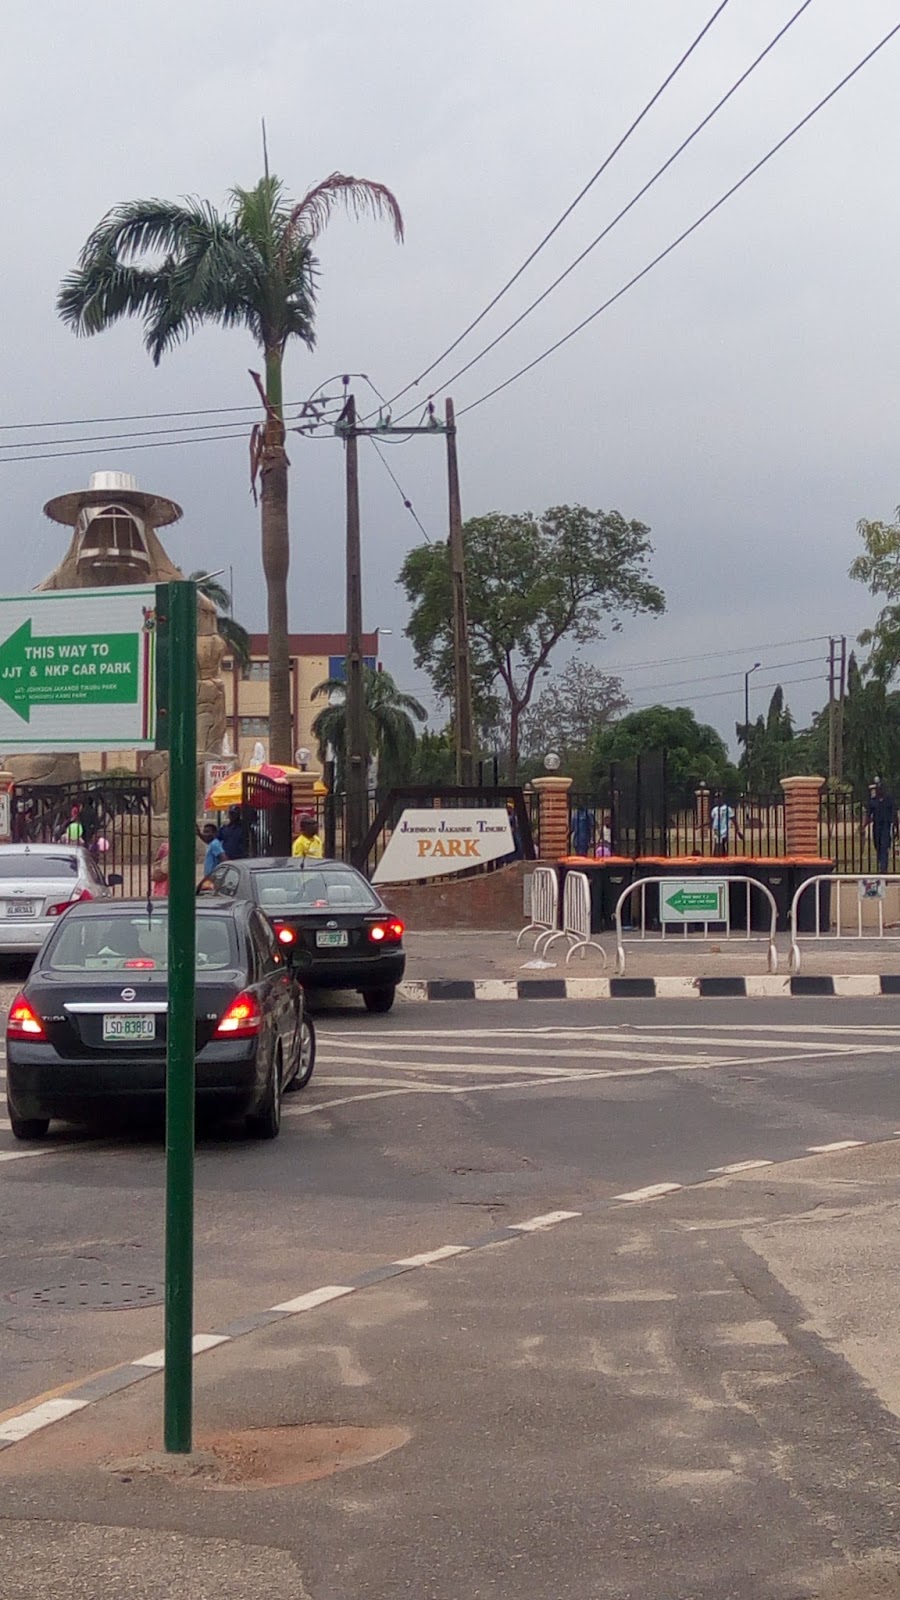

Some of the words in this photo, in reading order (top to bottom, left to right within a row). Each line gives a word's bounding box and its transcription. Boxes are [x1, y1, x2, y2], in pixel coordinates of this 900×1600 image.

[24, 646, 55, 659] THIS
[58, 644, 88, 658] WAY
[91, 643, 109, 656] TO
[2, 666, 22, 678] JJT
[29, 665, 38, 677] &
[45, 664, 69, 676] NKP
[72, 663, 97, 675] CAR
[100, 662, 131, 674] PARK
[417, 838, 481, 857] PARK
